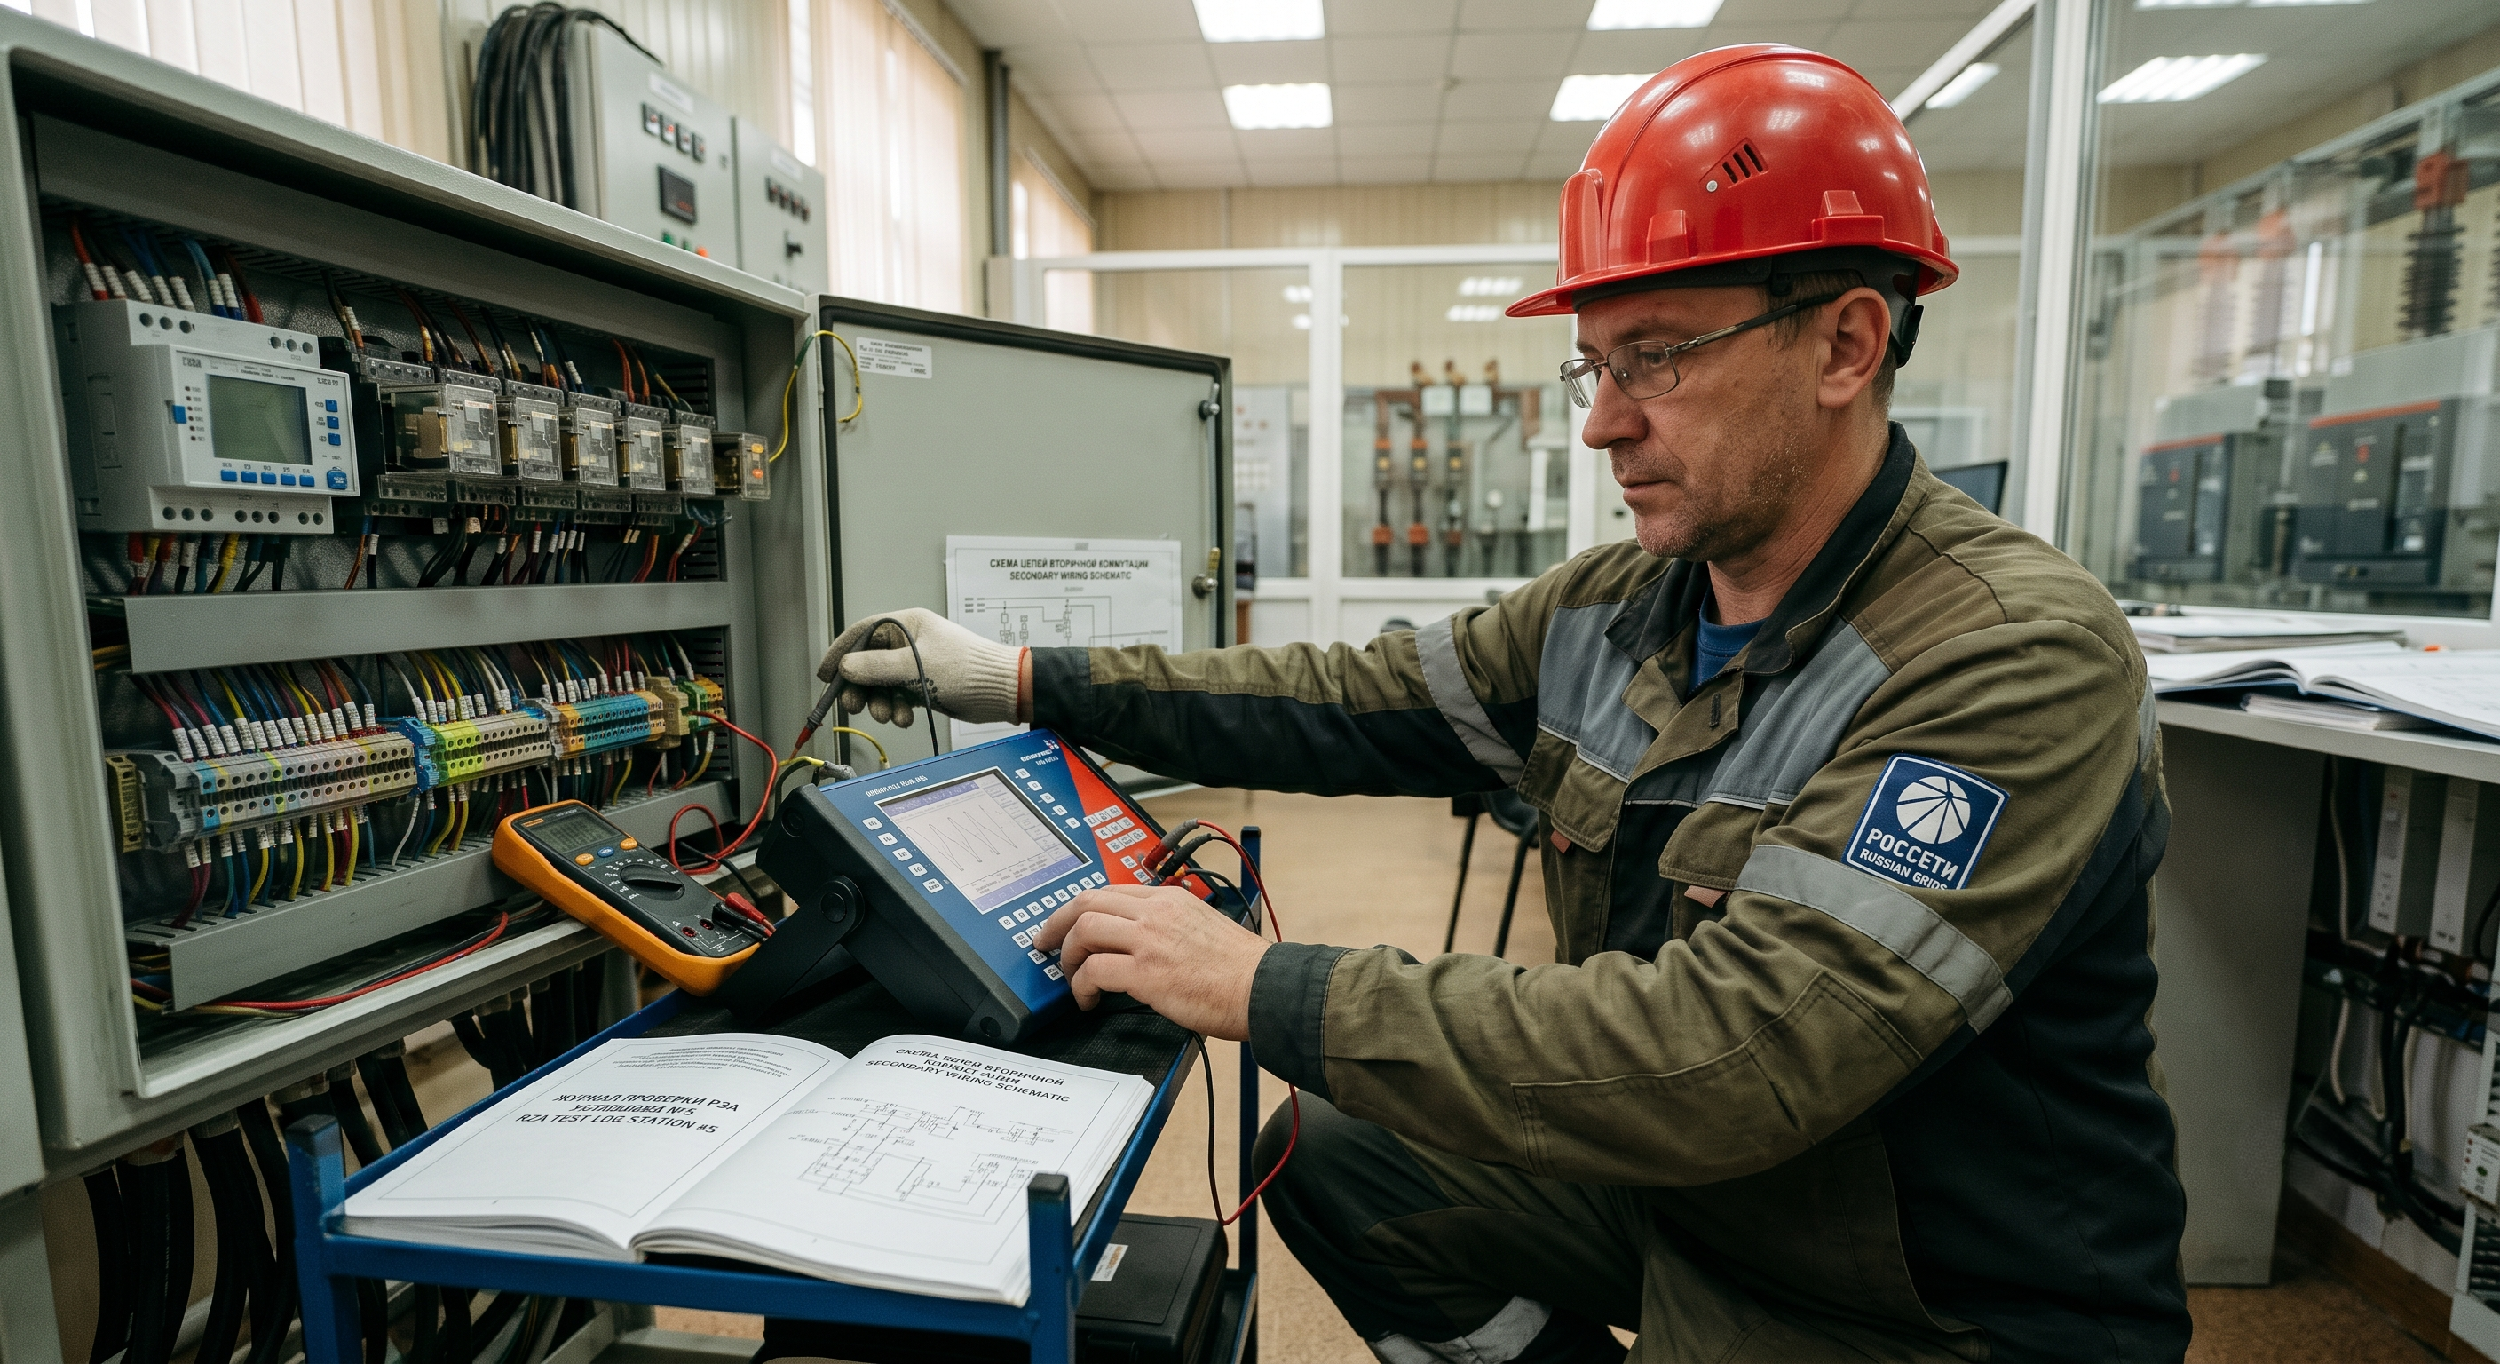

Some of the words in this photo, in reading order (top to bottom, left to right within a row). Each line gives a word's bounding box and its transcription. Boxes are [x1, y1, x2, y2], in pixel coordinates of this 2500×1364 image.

[990, 559, 1018, 568] СХЕМА
[1060, 571, 1088, 580] WIRING
[1865, 828, 1959, 881] РОССЕТИ
[1859, 848, 1911, 878] RUSSIAN
[995, 1082, 1071, 1102] SCHEMATIC
[706, 1098, 740, 1112] РЗА
[515, 1114, 550, 1122] RZA
[550, 1114, 592, 1122] TEST
[627, 1115, 697, 1129] STATION
